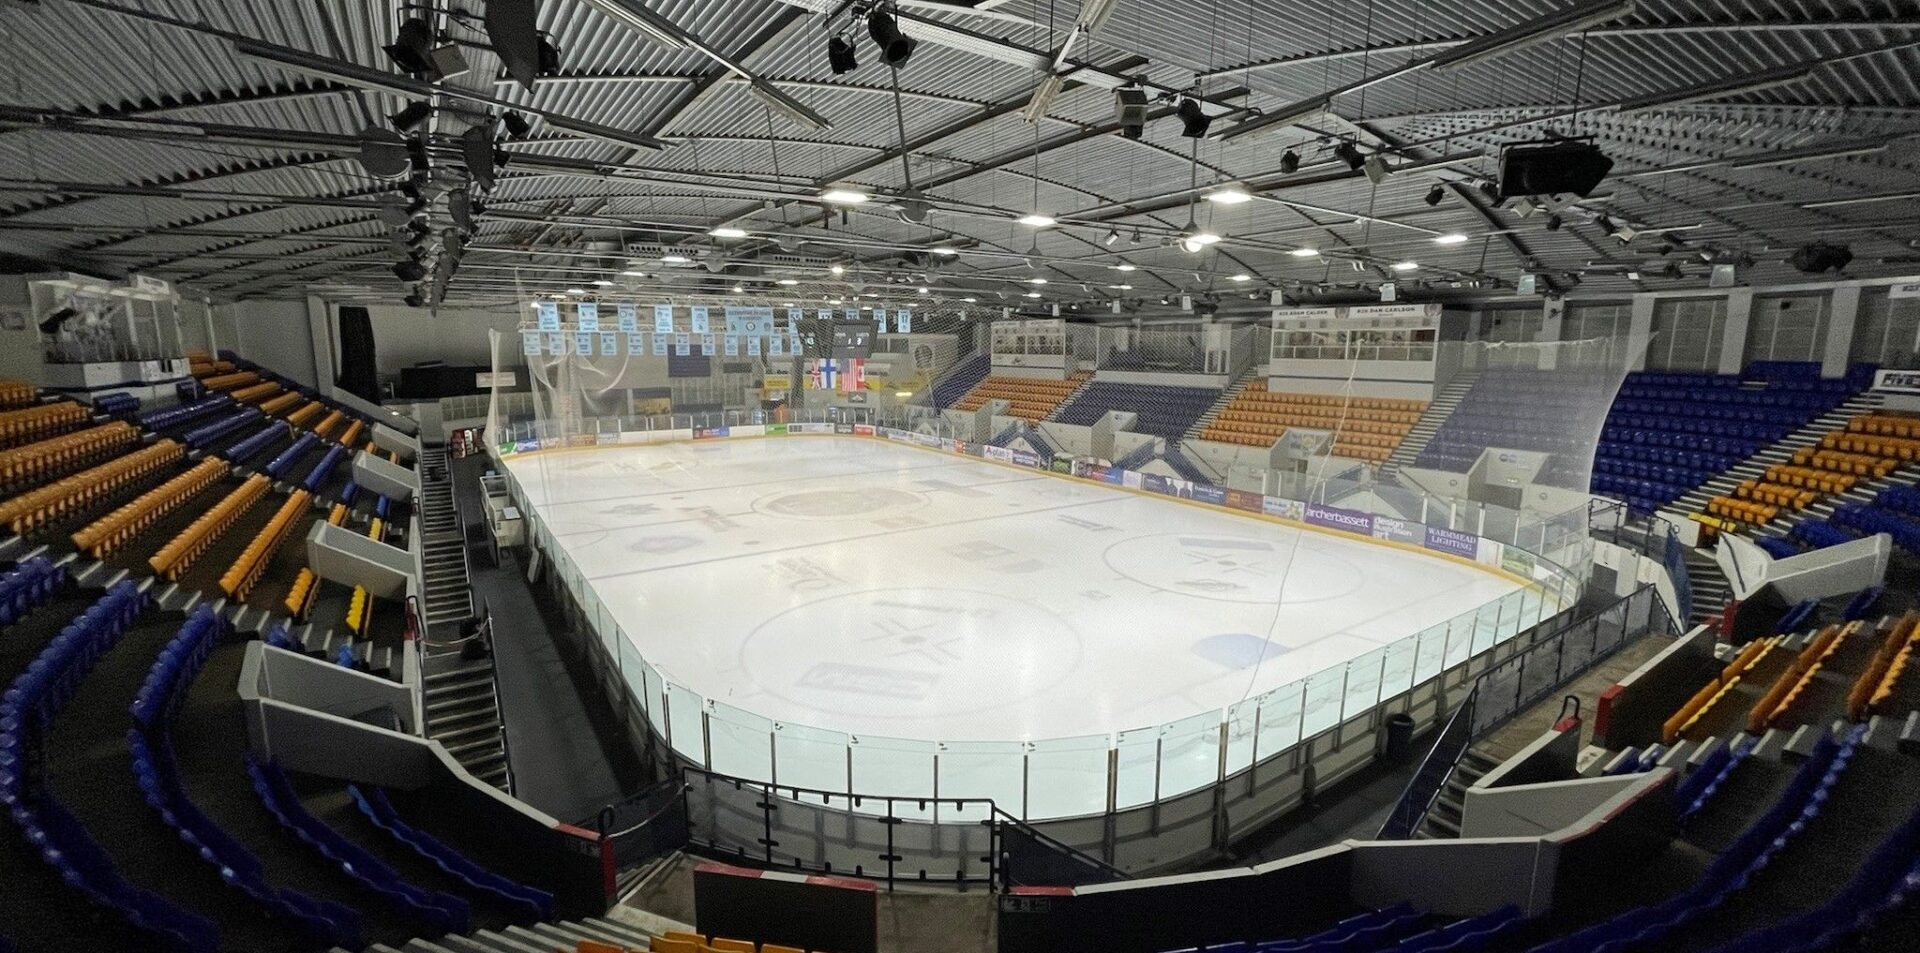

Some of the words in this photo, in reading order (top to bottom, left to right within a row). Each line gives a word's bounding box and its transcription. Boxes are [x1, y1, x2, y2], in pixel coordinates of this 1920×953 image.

[1306, 508, 1369, 529] archerbassett
[1374, 516, 1404, 530] design
[1373, 530, 1389, 540] art
[1428, 527, 1477, 544] WARMMEAD
[1431, 535, 1472, 551] LIGHTING
